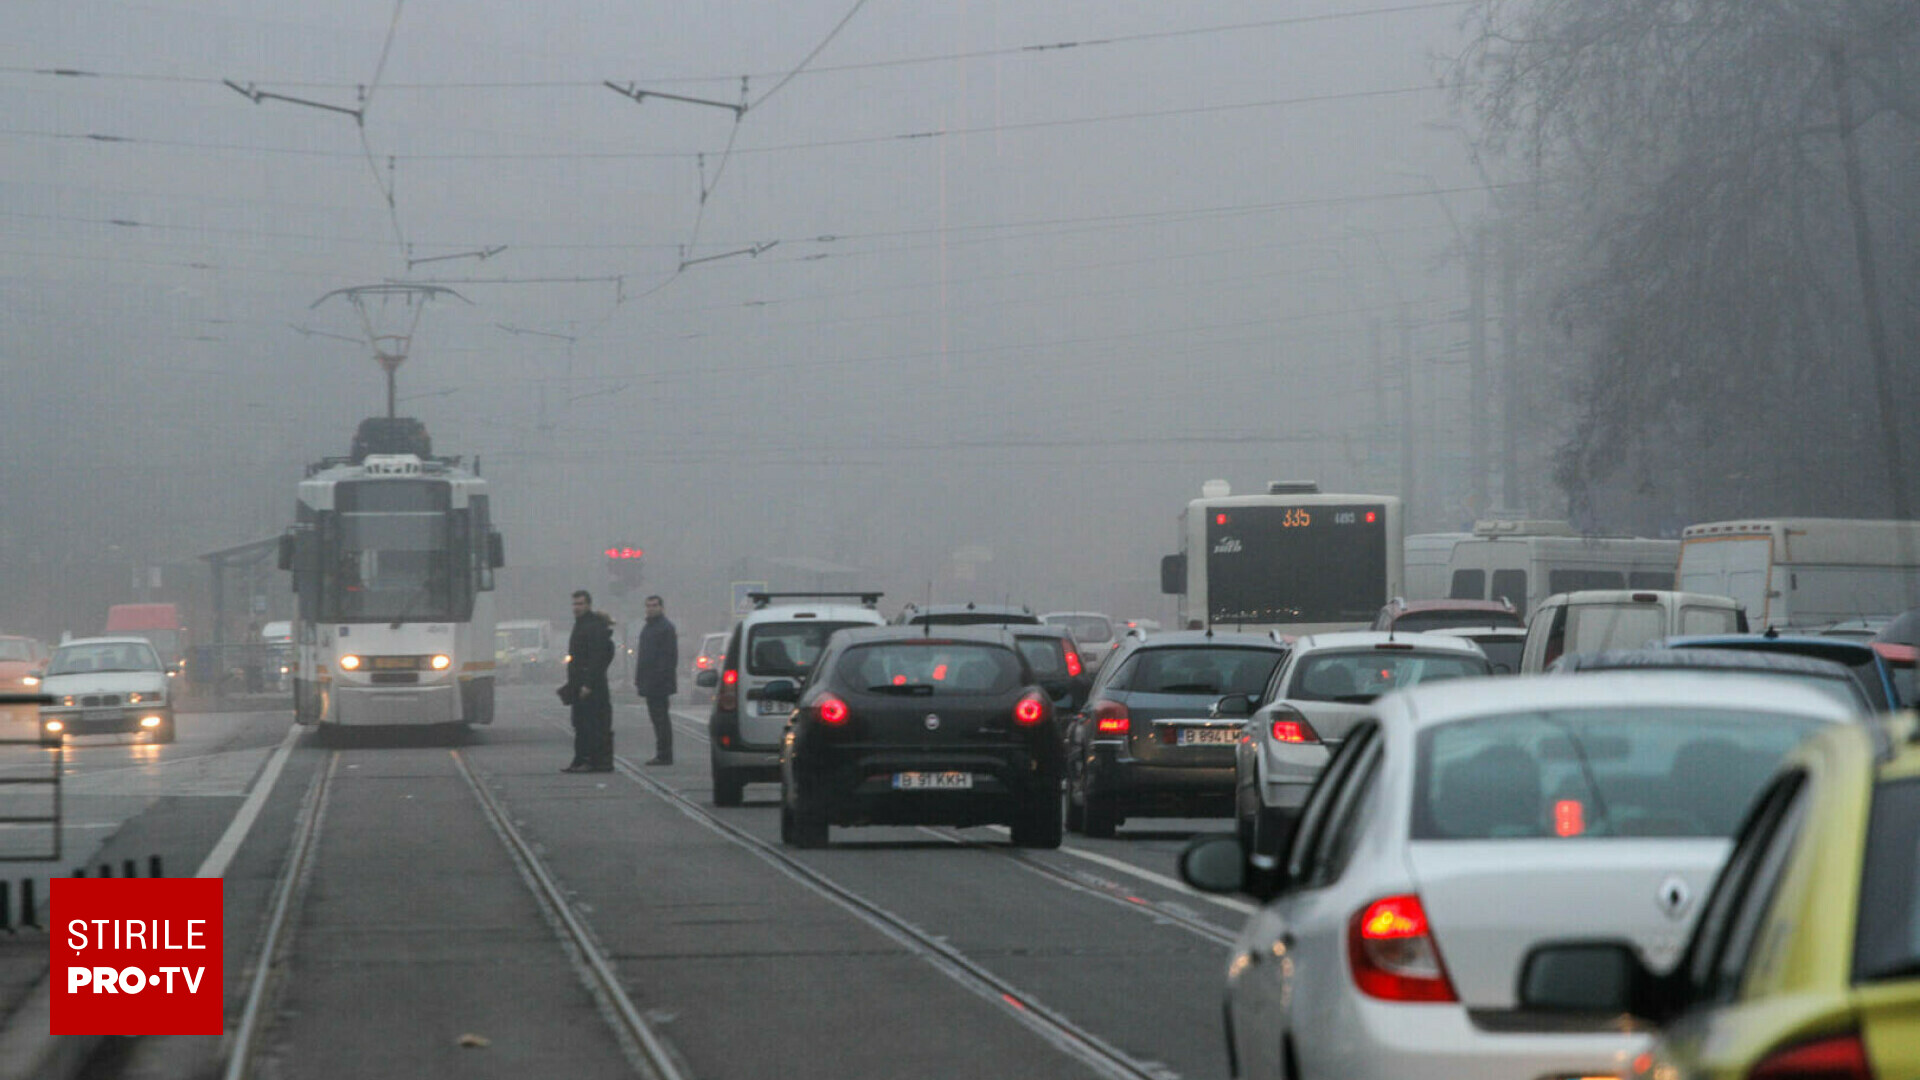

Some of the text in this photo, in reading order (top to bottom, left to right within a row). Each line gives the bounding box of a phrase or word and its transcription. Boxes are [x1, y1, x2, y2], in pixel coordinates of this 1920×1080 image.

[1282, 508, 1311, 527] 335
[1186, 729, 1196, 743] B
[1200, 729, 1221, 743] 894
[902, 773, 912, 787] B
[936, 773, 967, 787] KKH
